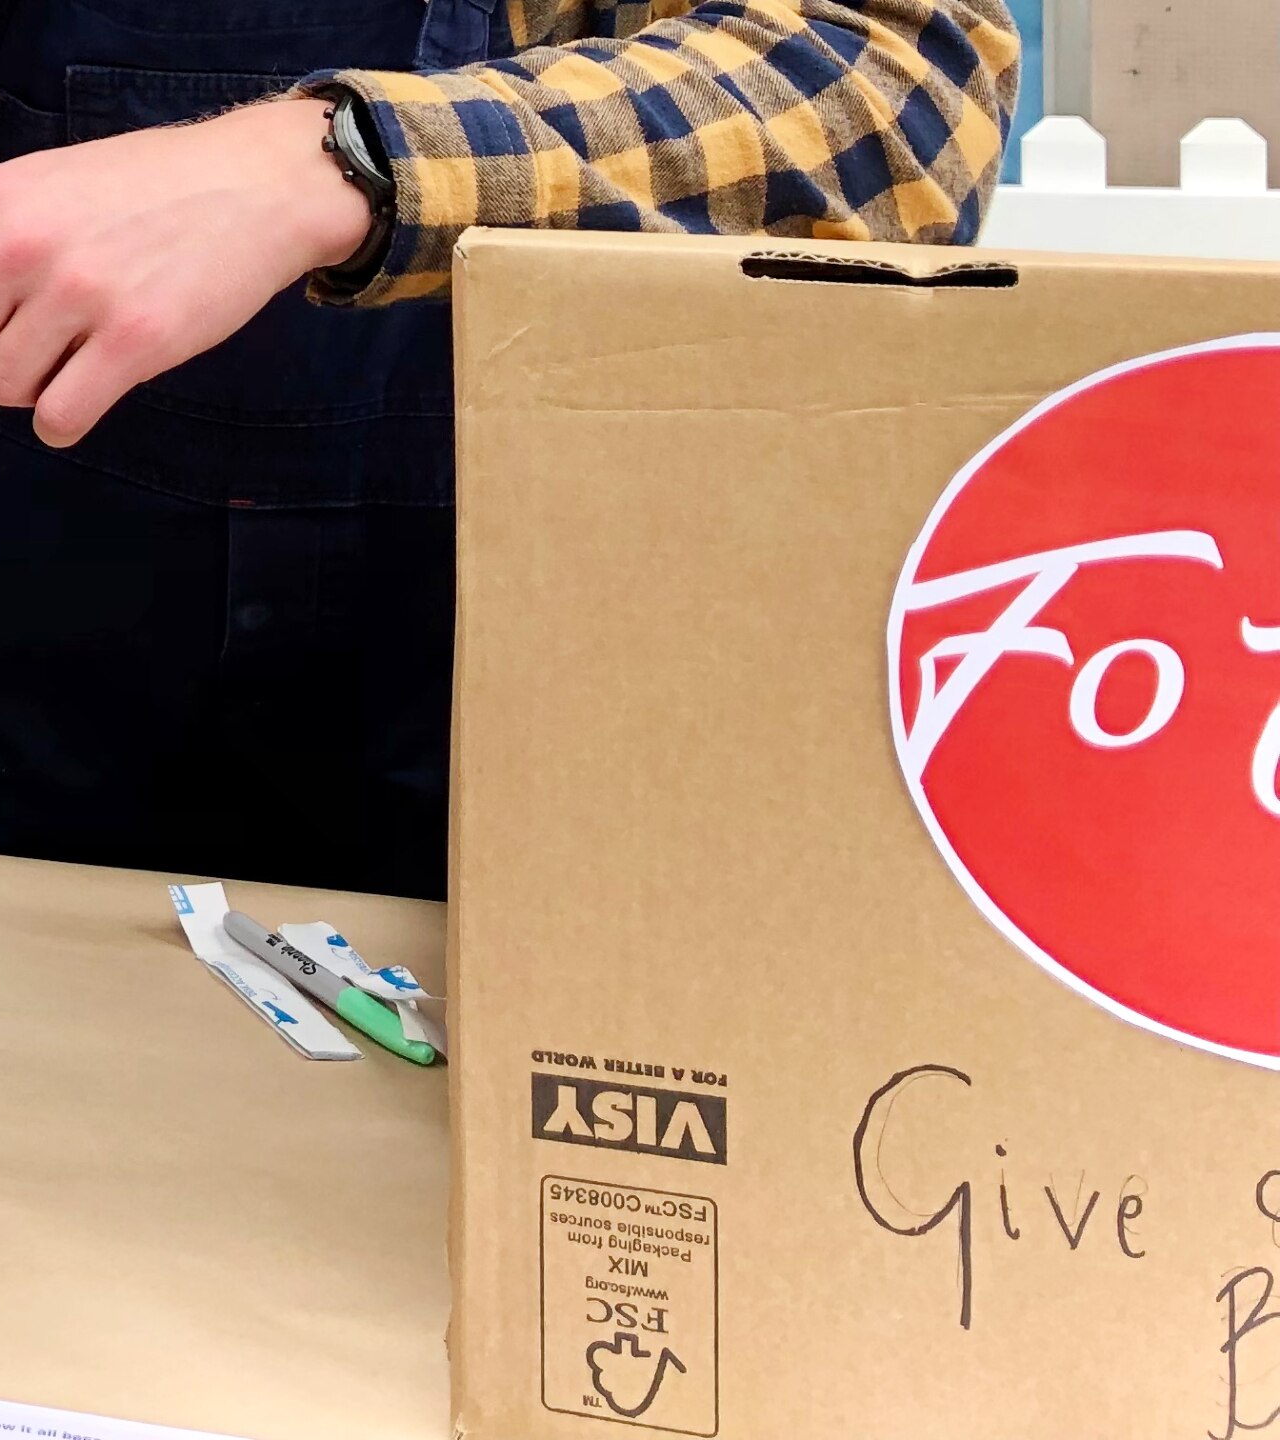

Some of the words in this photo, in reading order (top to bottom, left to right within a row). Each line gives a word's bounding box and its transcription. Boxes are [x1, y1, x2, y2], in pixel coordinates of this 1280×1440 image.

[531, 1049, 597, 1071] WORLD
[603, 1059, 666, 1079] BETTER
[671, 1066, 686, 1082] A
[692, 1068, 728, 1088] FOR
[542, 1084, 717, 1155] VISY
[549, 1183, 641, 1212] C008345
[853, 1064, 1146, 1330] Give
[549, 1212, 611, 1231] sources
[567, 1230, 603, 1249] from
[617, 1221, 710, 1247] responsible
[608, 1235, 692, 1263] Packaging
[608, 1255, 648, 1278] MIX
[584, 1276, 669, 1301] www.fsc.org
[586, 1297, 669, 1334] FSC
